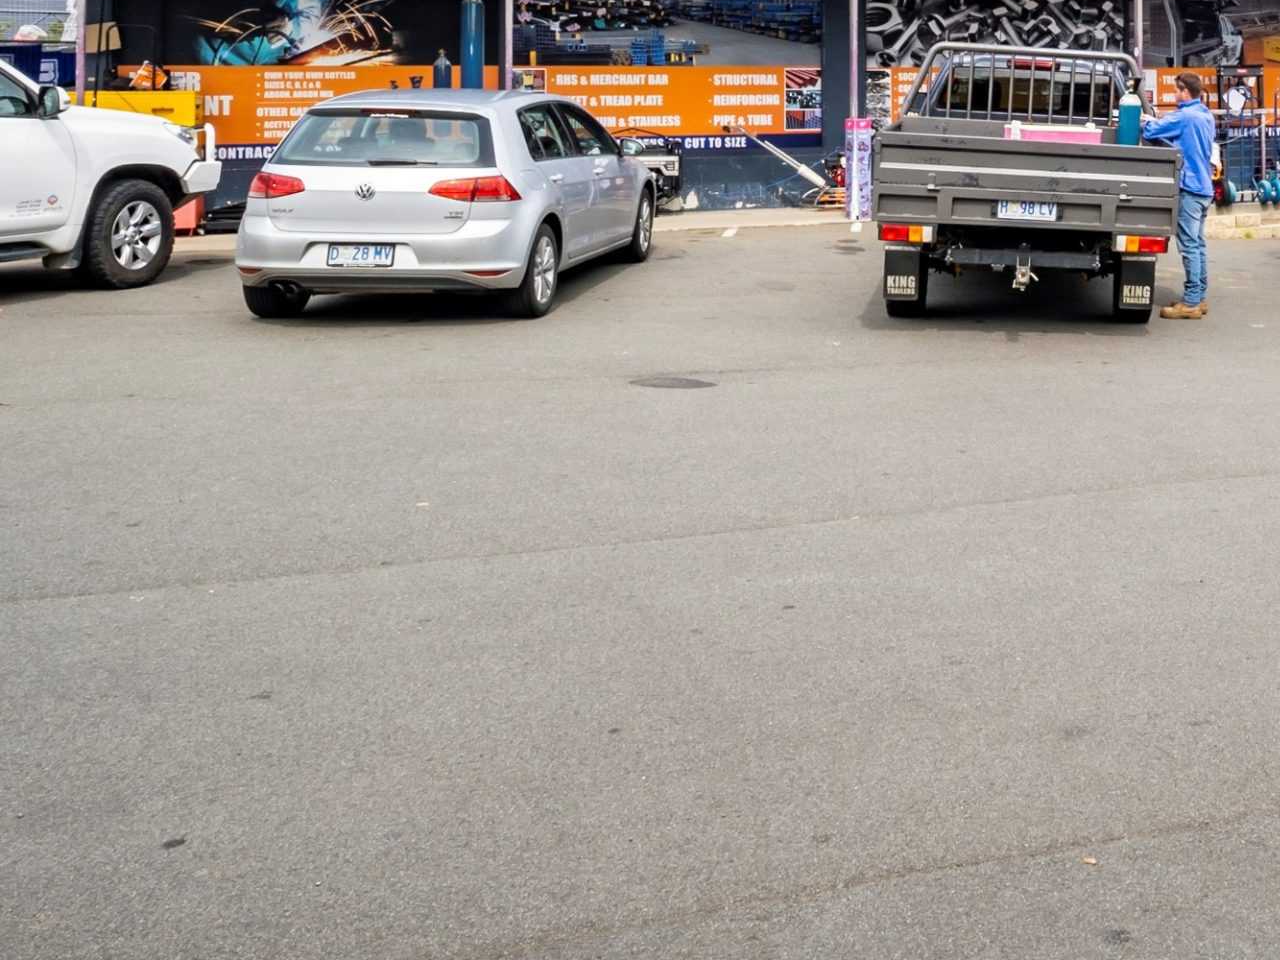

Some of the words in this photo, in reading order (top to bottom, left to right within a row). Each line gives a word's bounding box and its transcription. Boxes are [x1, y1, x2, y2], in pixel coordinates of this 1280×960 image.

[556, 74, 579, 86] RHS
[580, 76, 588, 85] &
[590, 74, 646, 86] MERCHANT
[647, 74, 669, 86] BAR
[713, 74, 779, 86] STRUCTURAL
[590, 96, 598, 107] &
[600, 95, 634, 107] TREAD
[635, 95, 664, 107] PLATE
[713, 94, 780, 106] REINFORCING
[256, 107, 288, 117] OTHER
[618, 117, 627, 127] &
[628, 115, 681, 128] STAINLESS
[713, 114, 737, 126] PIPE
[737, 116, 746, 126] &
[747, 114, 773, 126] TUBE
[684, 137, 707, 149] CUT
[708, 137, 722, 149] TO
[724, 136, 747, 148] SIZE
[214, 147, 279, 159] ONTRAC
[1020, 200, 1035, 215] 98
[330, 247, 339, 261] D
[353, 247, 369, 261] 28
[373, 247, 393, 261] MV
[887, 275, 915, 288] KING
[1123, 285, 1150, 298] KING
